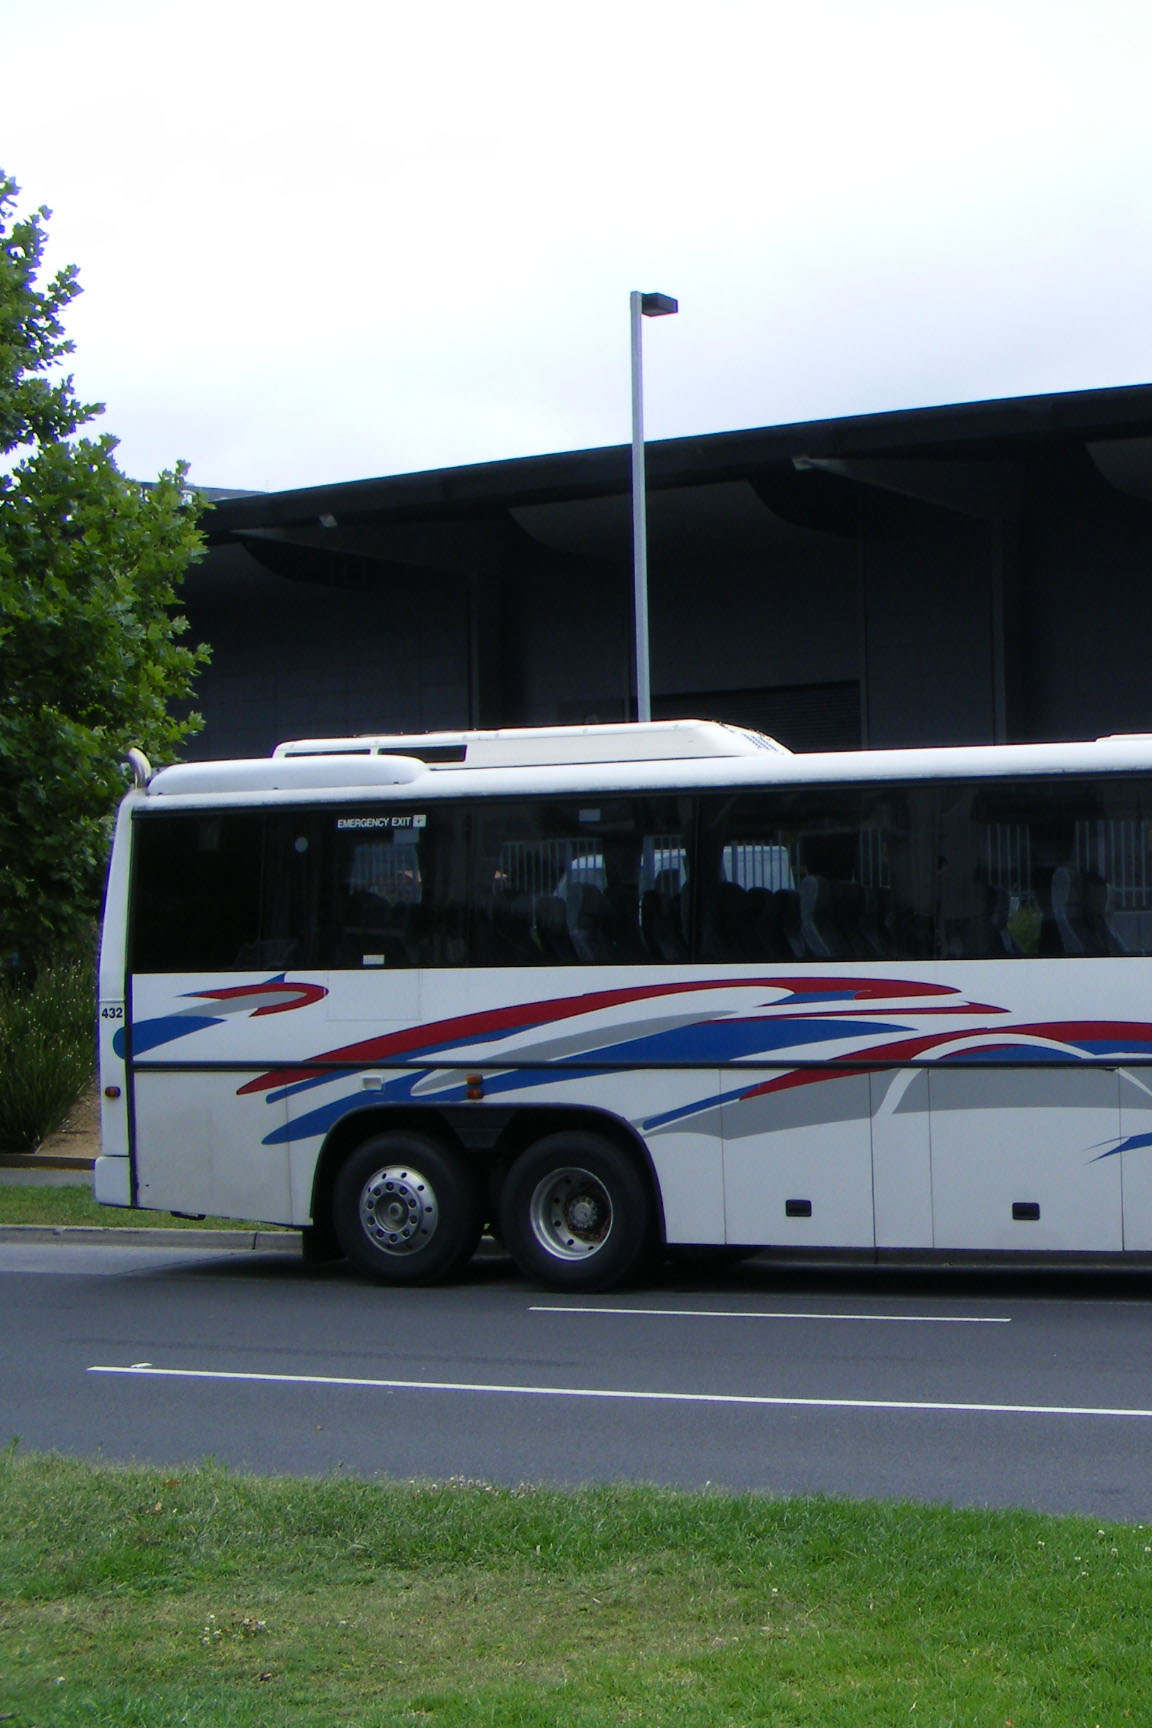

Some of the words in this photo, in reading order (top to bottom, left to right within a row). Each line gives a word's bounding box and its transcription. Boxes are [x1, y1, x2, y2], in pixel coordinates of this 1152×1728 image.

[339, 817, 389, 828] EMERGENCY
[392, 816, 411, 827] EXIT
[102, 1007, 123, 1018] 432
